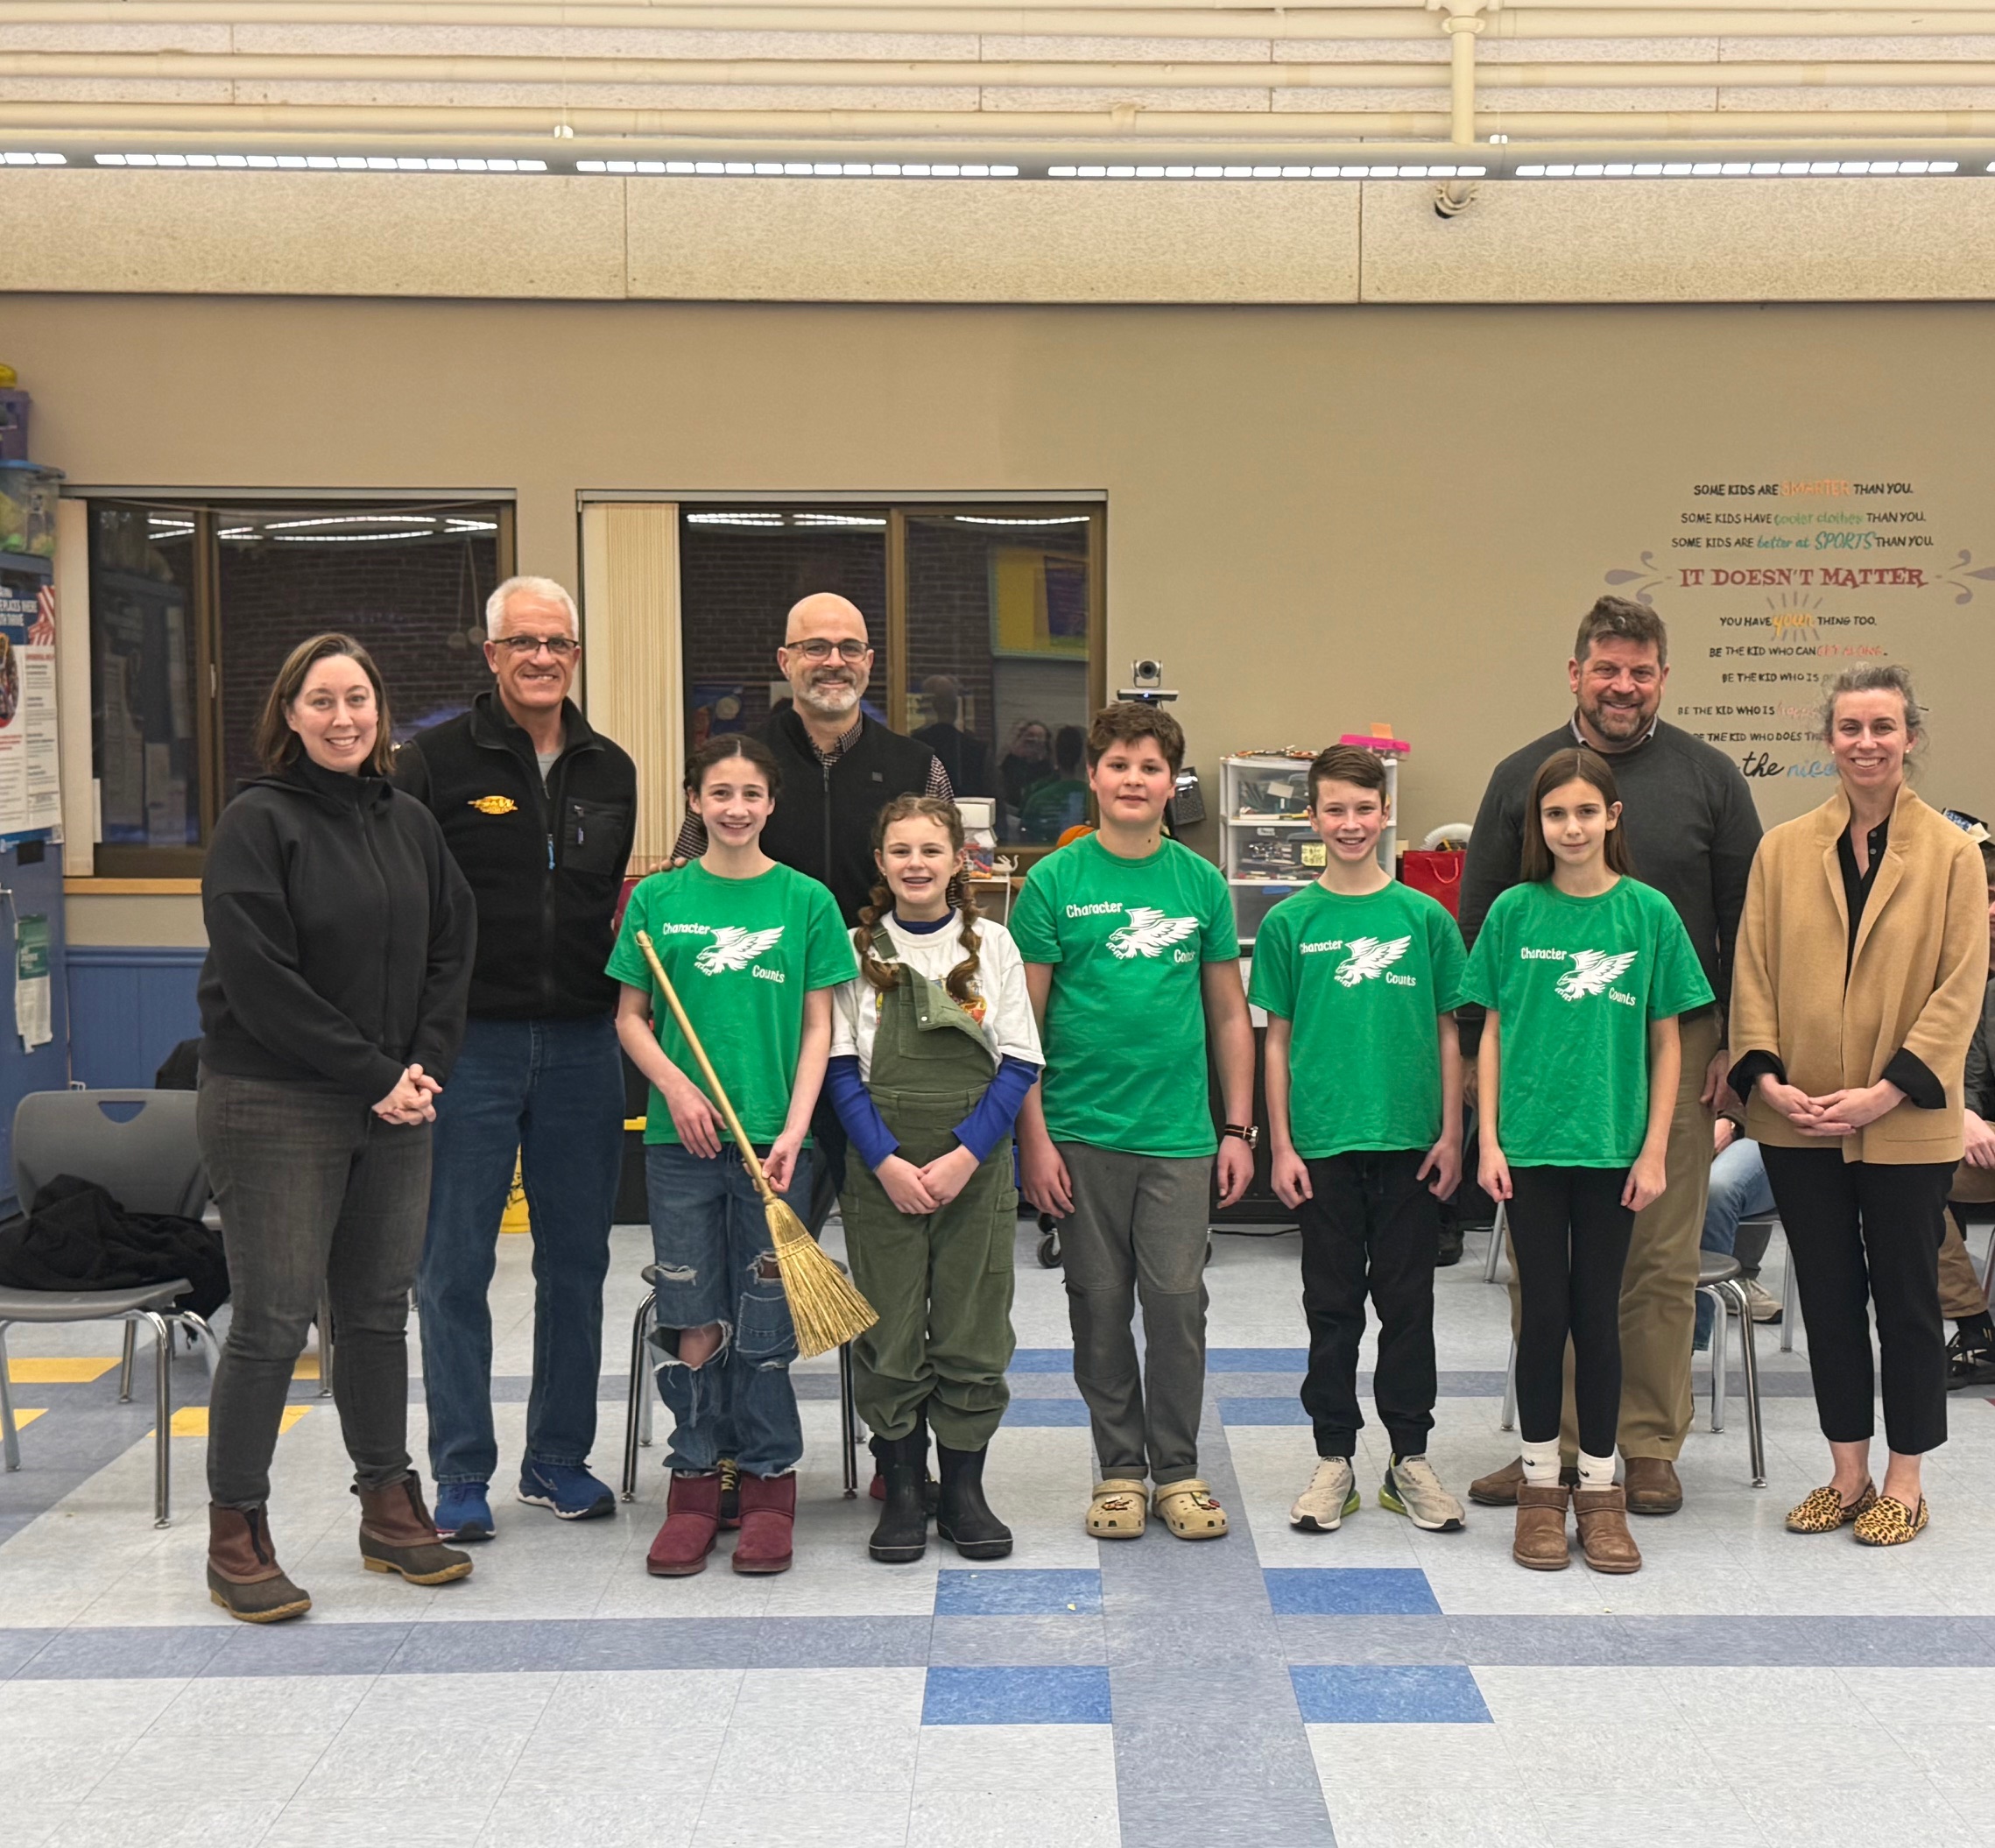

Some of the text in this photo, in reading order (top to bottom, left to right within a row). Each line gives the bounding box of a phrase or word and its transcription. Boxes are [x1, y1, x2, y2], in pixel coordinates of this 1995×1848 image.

[1694, 480, 1914, 497] SOME KIDS ARE SMARTER THAN YOU.
[1681, 511, 1926, 525] SOME KIDS HAVE cooler clothes THAN YOU.
[1671, 531, 1934, 551] SOME KIDS ARE better at SPORTS THAN YOU.
[1678, 567, 1929, 589] IT DOESN'T MATTER
[1719, 616, 1743, 626] YOU
[1744, 616, 1773, 627] HAVE
[1817, 616, 1850, 626] THING
[1853, 615, 1878, 626] TOO.
[1709, 646, 1723, 658] BE
[1725, 645, 1745, 656] THE
[1747, 645, 1766, 656] KID
[1769, 646, 1794, 656] WHO
[1795, 645, 1816, 656] CAN
[1722, 673, 1734, 683] BE
[1737, 673, 1757, 682] THE
[1759, 673, 1777, 682] KID
[1780, 672, 1804, 682] WHO
[1806, 673, 1819, 682] IS
[1693, 706, 1712, 715] THE
[1716, 705, 1733, 715] KID
[1736, 705, 1761, 716] WHO
[1762, 705, 1775, 715] IS
[1707, 732, 1727, 742] THE
[1729, 732, 1746, 742] KID
[1750, 732, 1774, 742] WHO
[1775, 731, 1801, 742] DOES
[1742, 751, 1785, 778] the
[1066, 900, 1123, 918] Character
[663, 922, 710, 935] Character
[1299, 940, 1343, 955] Character
[1520, 947, 1567, 960] Character
[752, 964, 786, 984] Counts
[1385, 971, 1417, 987] Counts
[1609, 986, 1636, 1006] Counts
